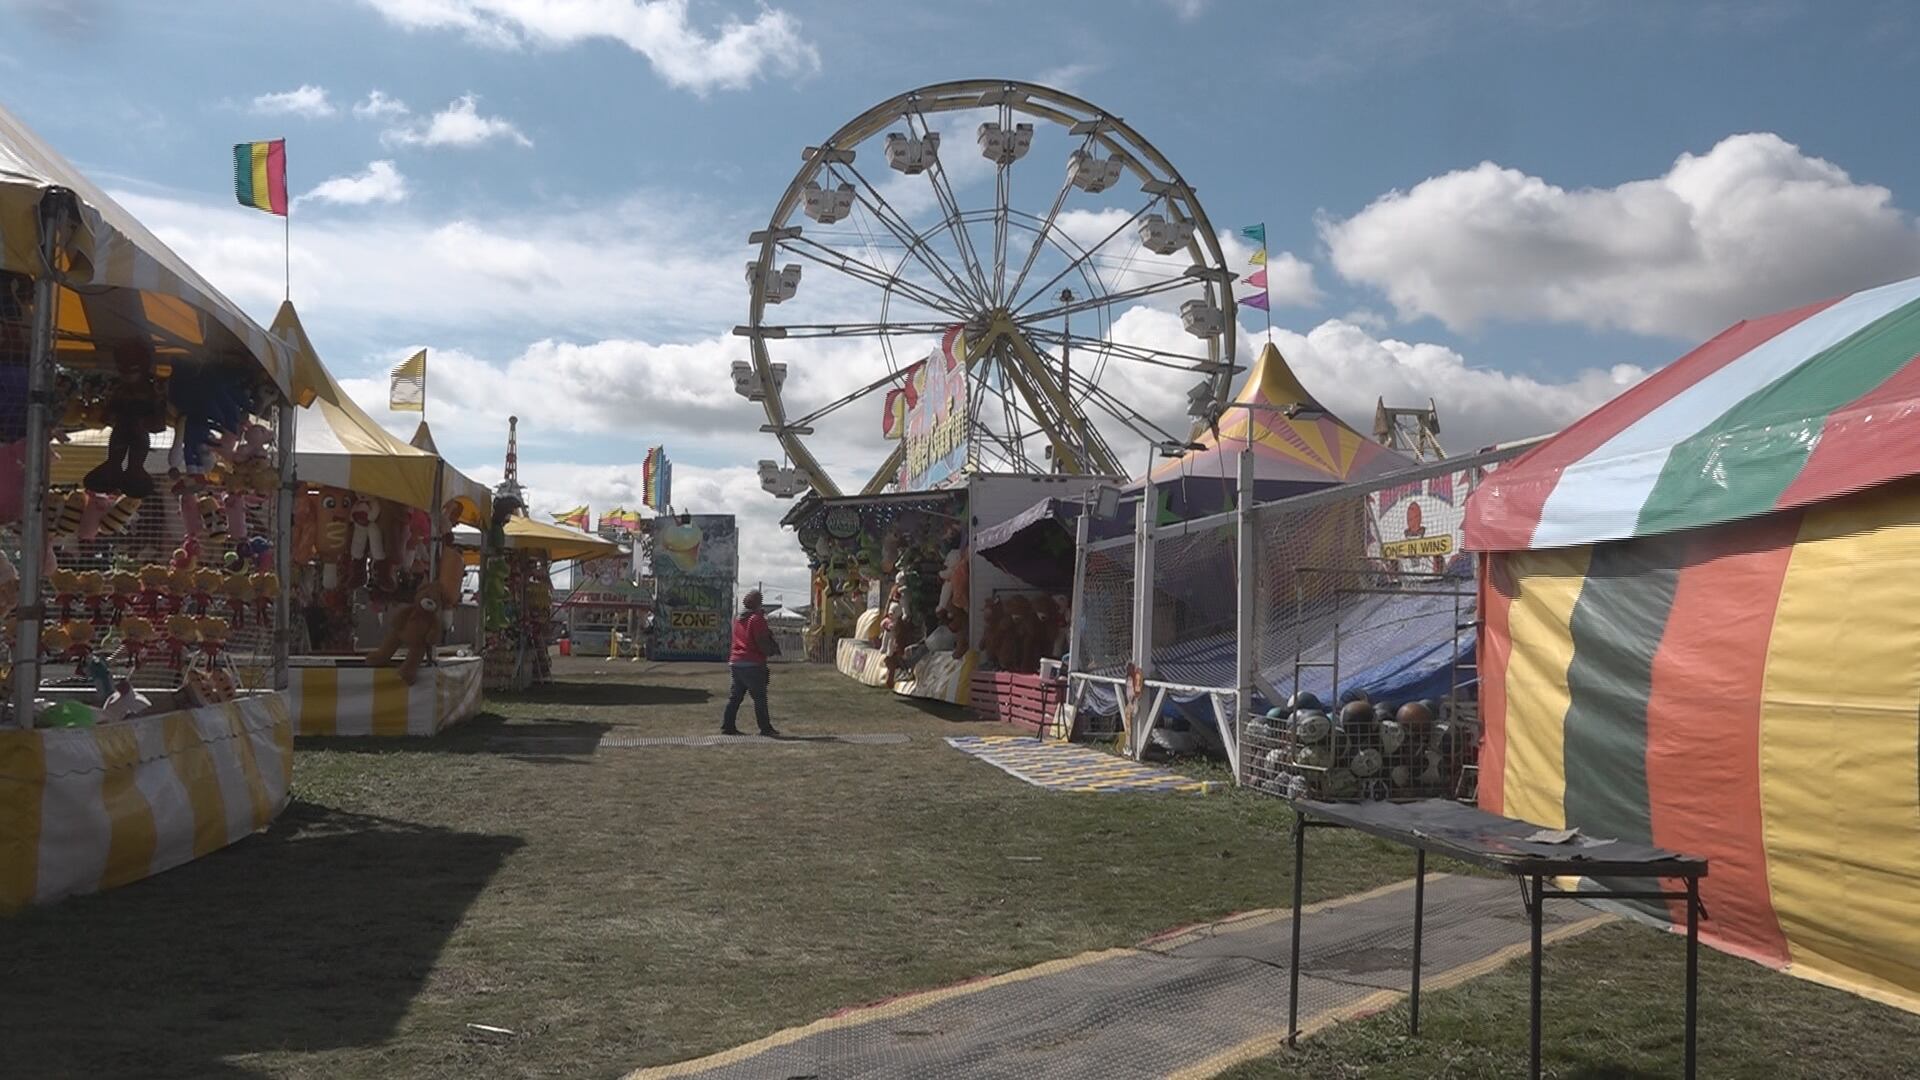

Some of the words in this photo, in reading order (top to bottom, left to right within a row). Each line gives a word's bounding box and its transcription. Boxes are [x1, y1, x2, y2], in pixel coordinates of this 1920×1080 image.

[1384, 544, 1407, 558] ONE
[1408, 543, 1417, 555] IN
[1420, 539, 1448, 553] WINS
[672, 613, 716, 626] ZONE
